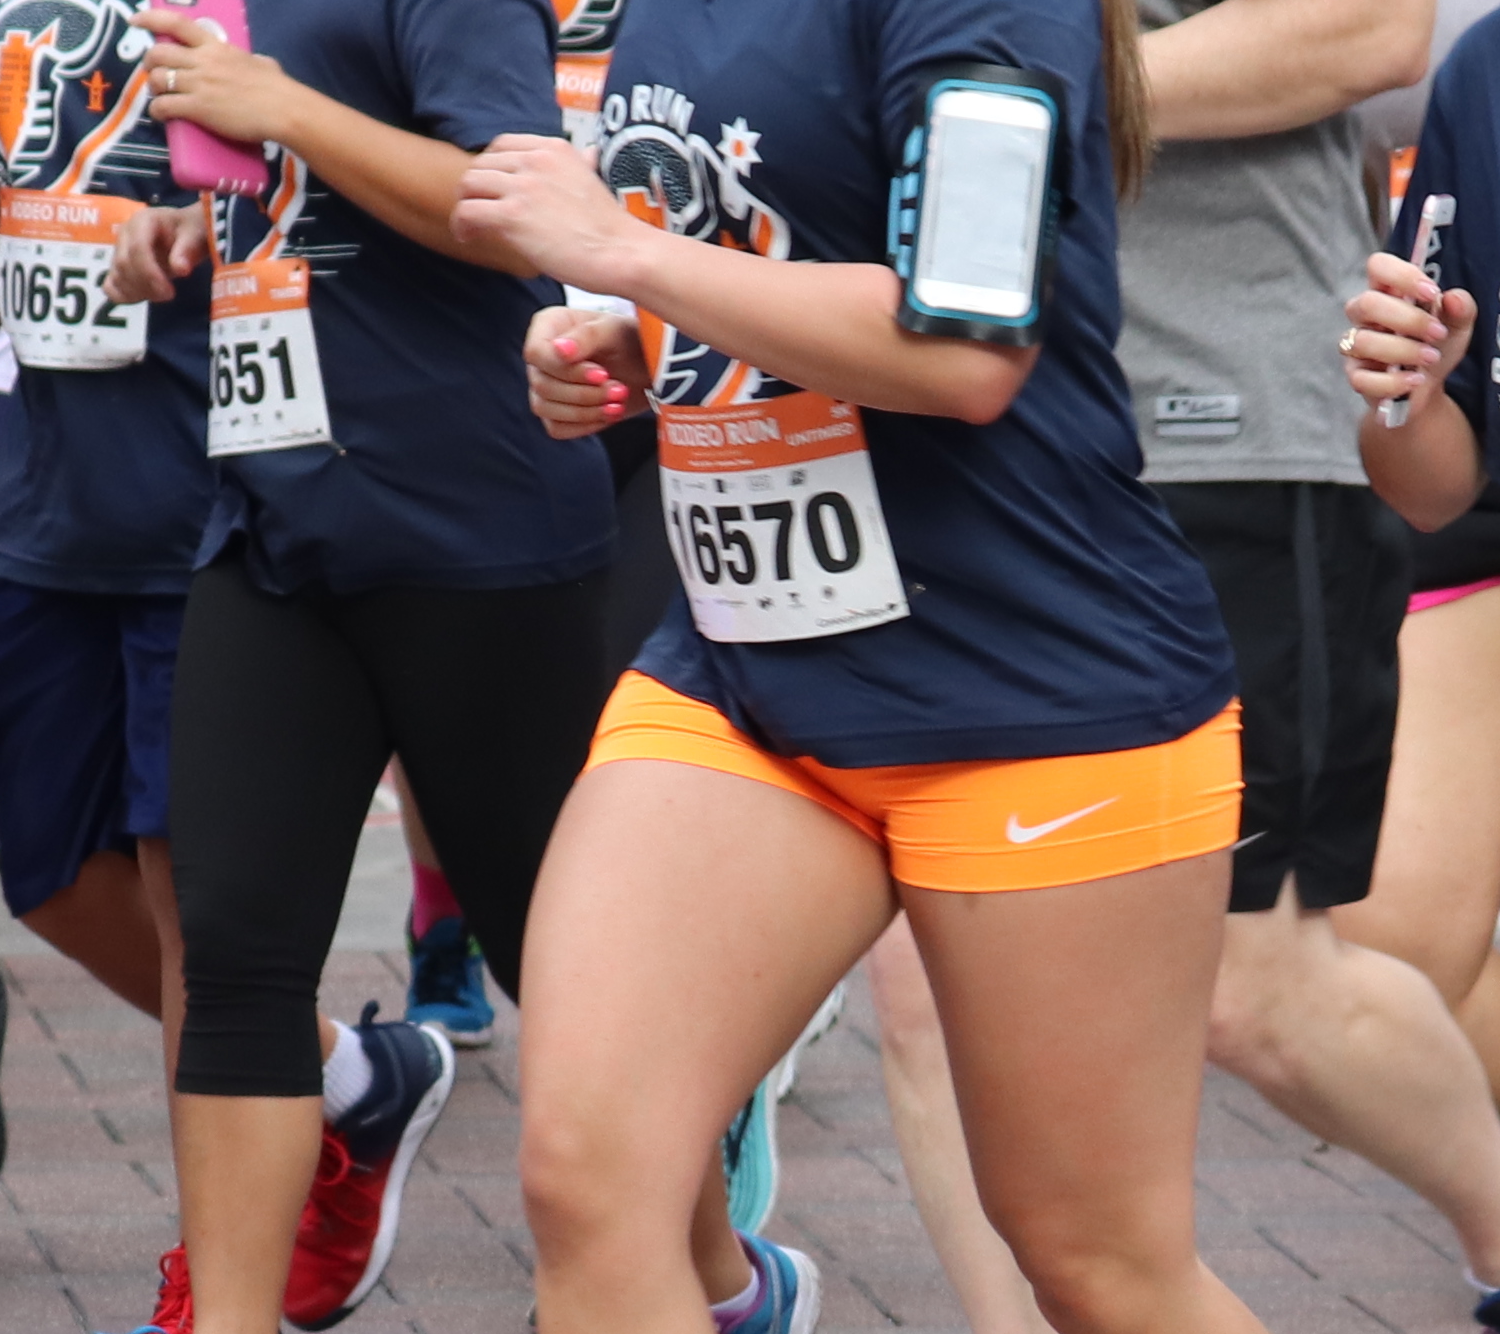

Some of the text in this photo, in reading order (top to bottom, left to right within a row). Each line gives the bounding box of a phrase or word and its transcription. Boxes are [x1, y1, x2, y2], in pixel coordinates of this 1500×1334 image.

[631, 83, 695, 138] RUN
[57, 205, 99, 226] RUN
[1, 260, 128, 330] 10652
[208, 336, 298, 410] 651
[724, 417, 782, 445] RUN
